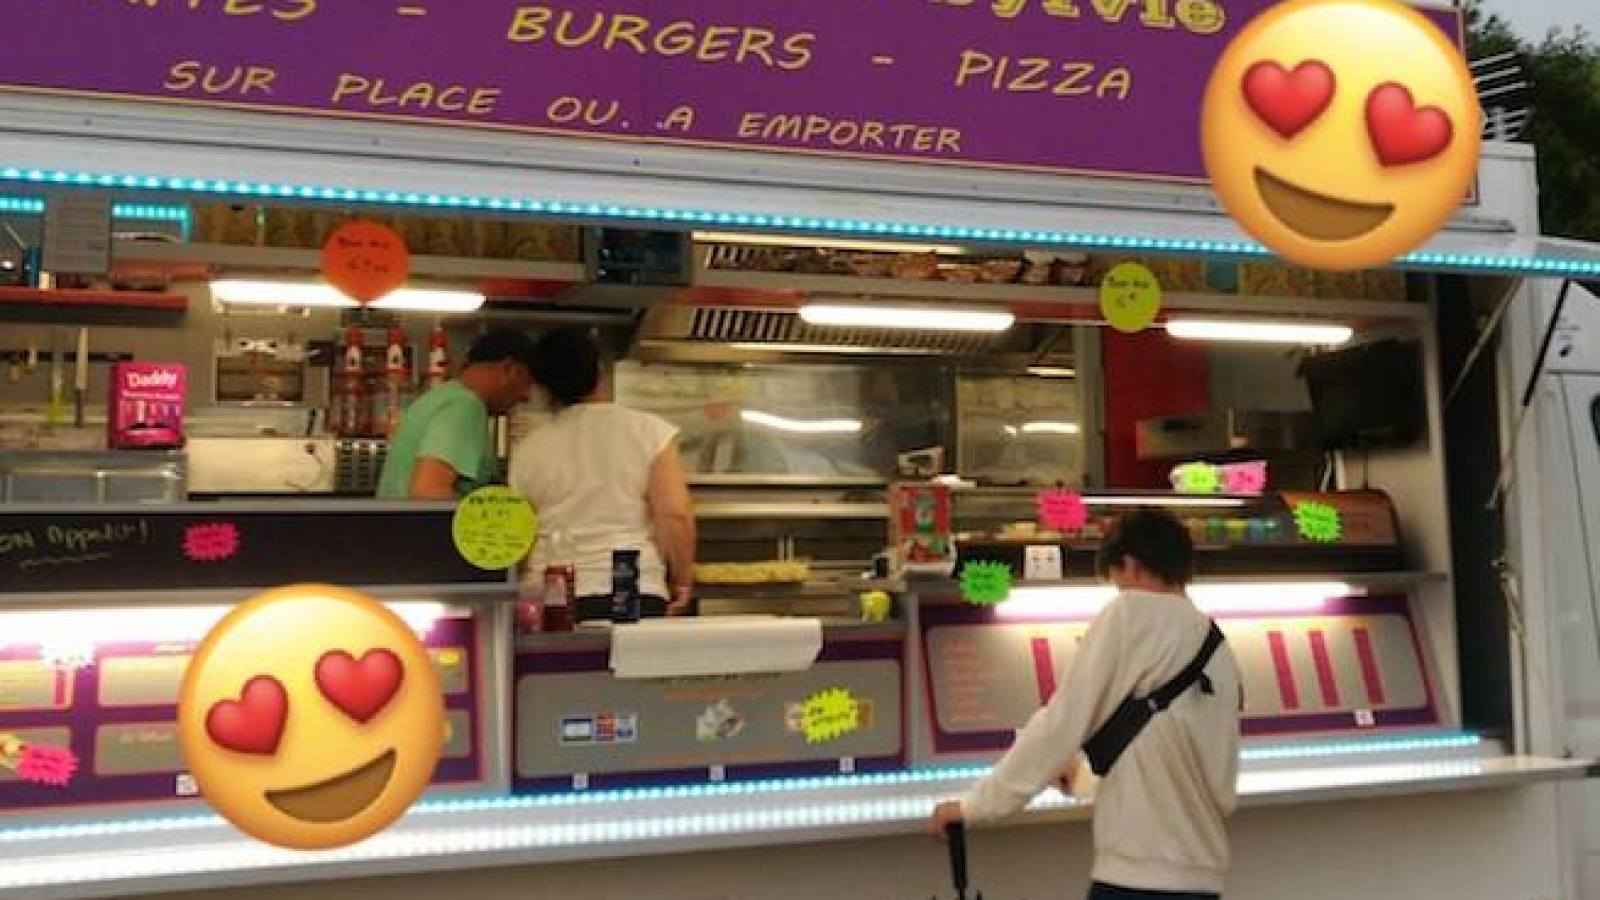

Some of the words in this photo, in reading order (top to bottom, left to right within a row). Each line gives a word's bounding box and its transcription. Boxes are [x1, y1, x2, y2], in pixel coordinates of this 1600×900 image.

[934, 0, 1225, 34] vie
[506, 6, 817, 70] BURGERS
[954, 49, 1133, 100] PIZZA
[163, 60, 277, 95] SUR
[331, 73, 502, 114] PLACE
[737, 111, 962, 153] EMPORTER
[125, 368, 178, 390] Daddy
